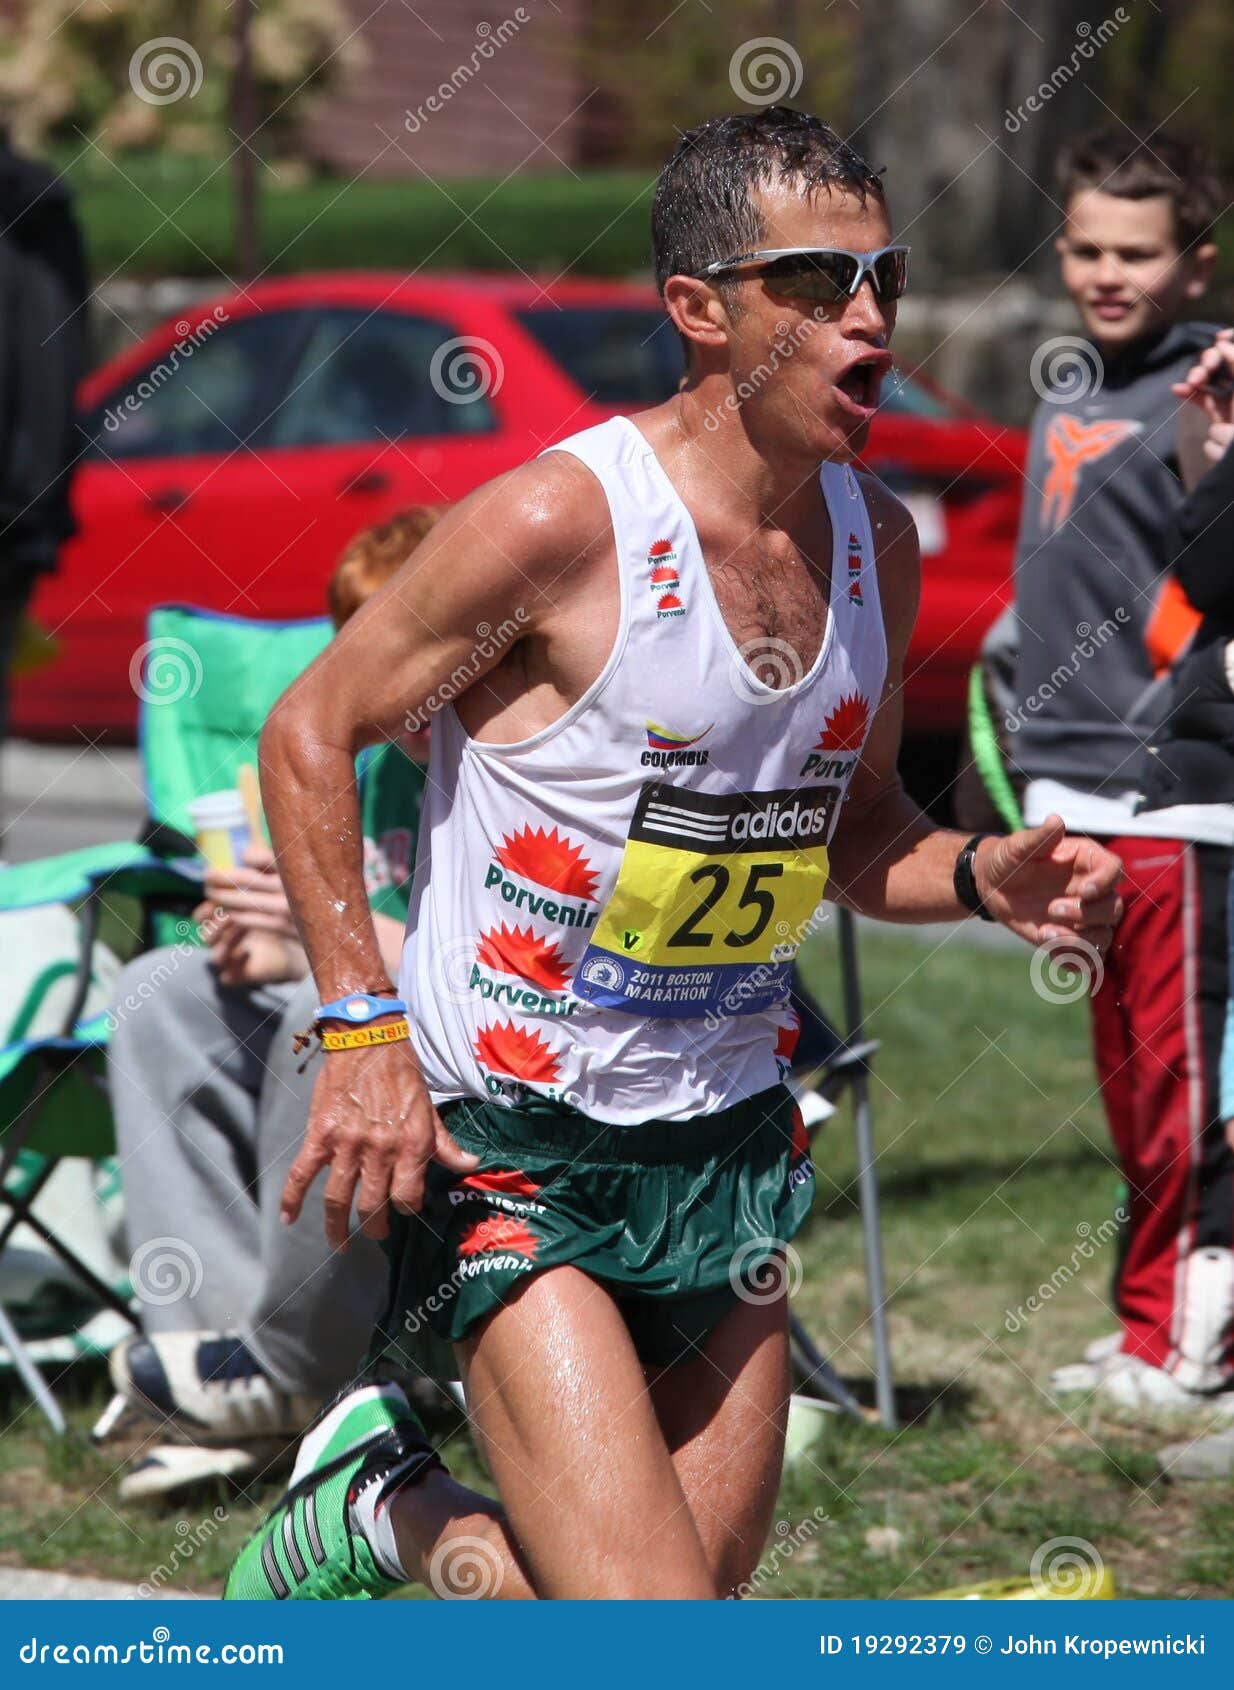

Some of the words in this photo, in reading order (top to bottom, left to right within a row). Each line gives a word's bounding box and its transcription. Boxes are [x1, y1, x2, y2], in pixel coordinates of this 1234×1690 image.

[731, 802, 827, 839] adidas
[484, 863, 598, 928] Porvenir
[666, 863, 784, 948] 25
[469, 962, 578, 1016] Porvenir
[624, 984, 709, 1002] MARATHON
[630, 970, 665, 986] 2011
[666, 972, 714, 986] BOSTON
[448, 1191, 546, 1215] Povenir
